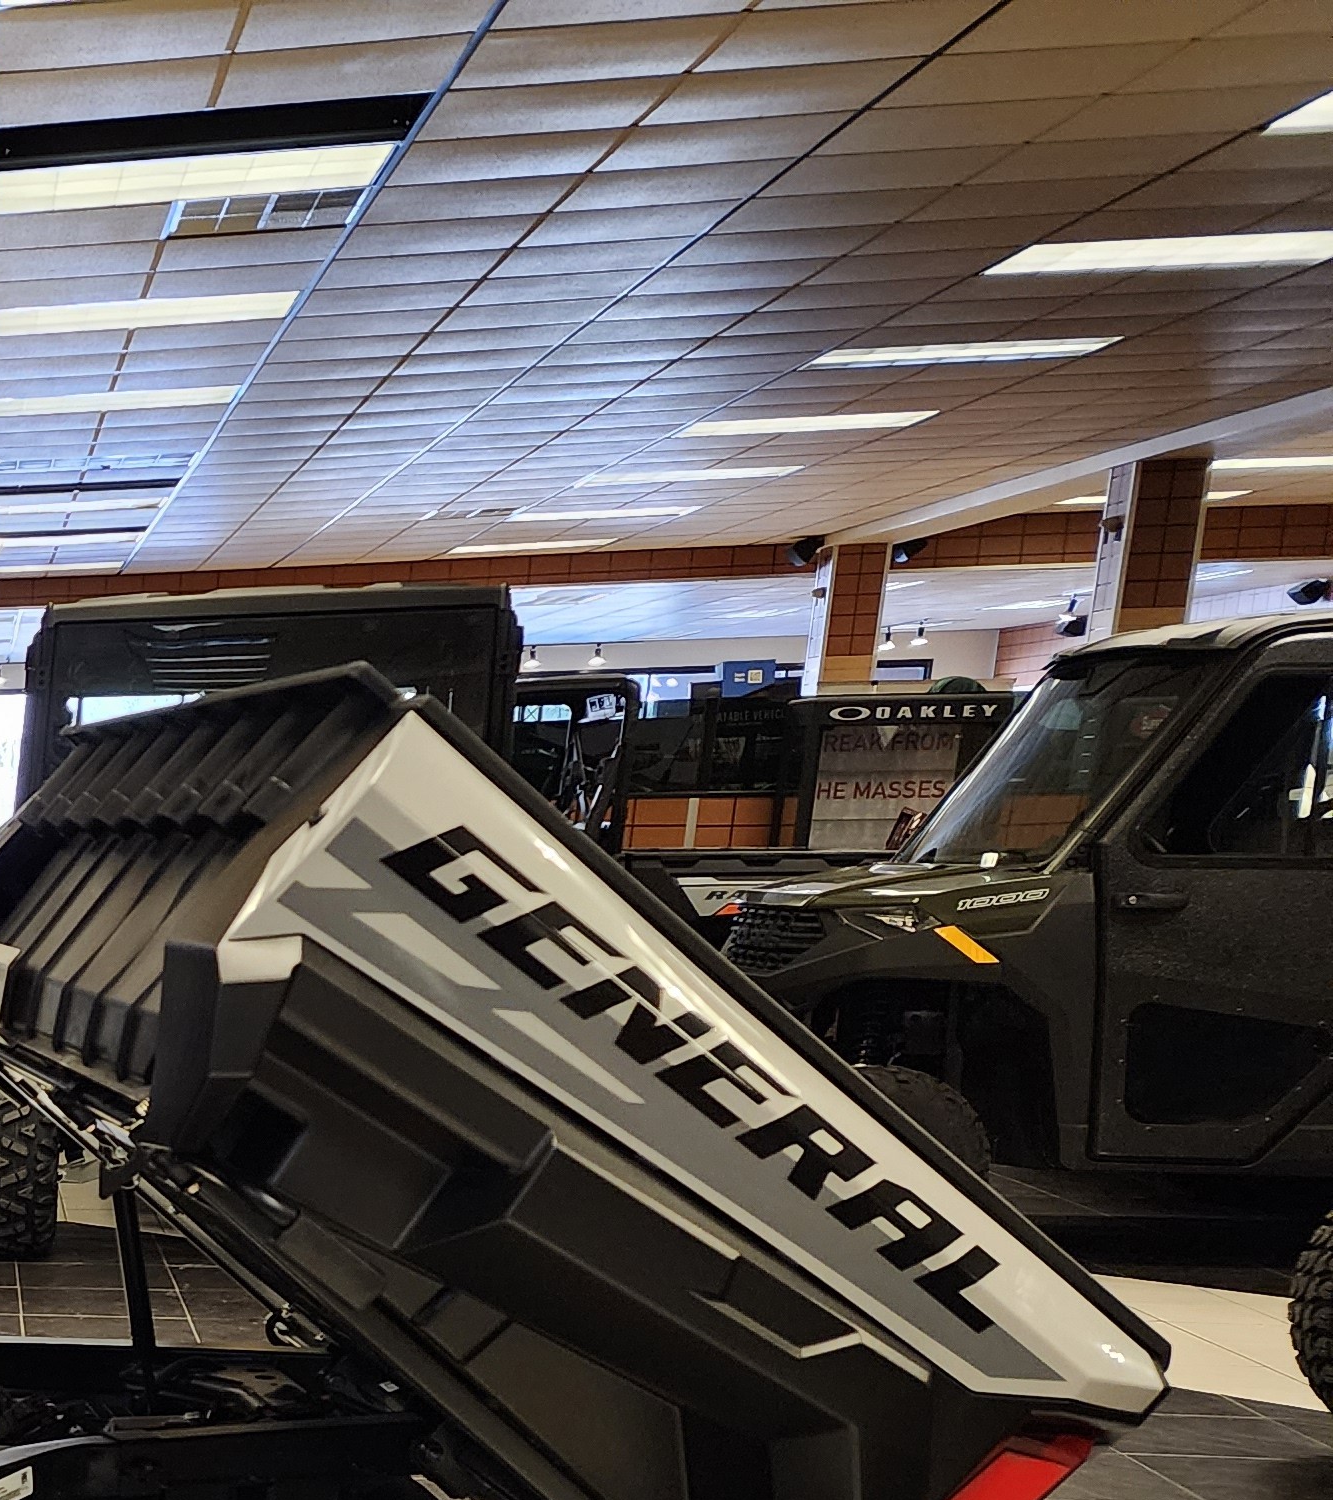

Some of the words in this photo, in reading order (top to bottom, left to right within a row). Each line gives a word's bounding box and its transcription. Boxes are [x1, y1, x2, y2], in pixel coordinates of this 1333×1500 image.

[876, 704, 998, 719] OAKLEY
[823, 732, 883, 753] REAK
[817, 781, 848, 800] HE
[852, 780, 946, 800] MASSES
[956, 889, 1050, 911] 1000
[380, 825, 1001, 1334] GENERAL
